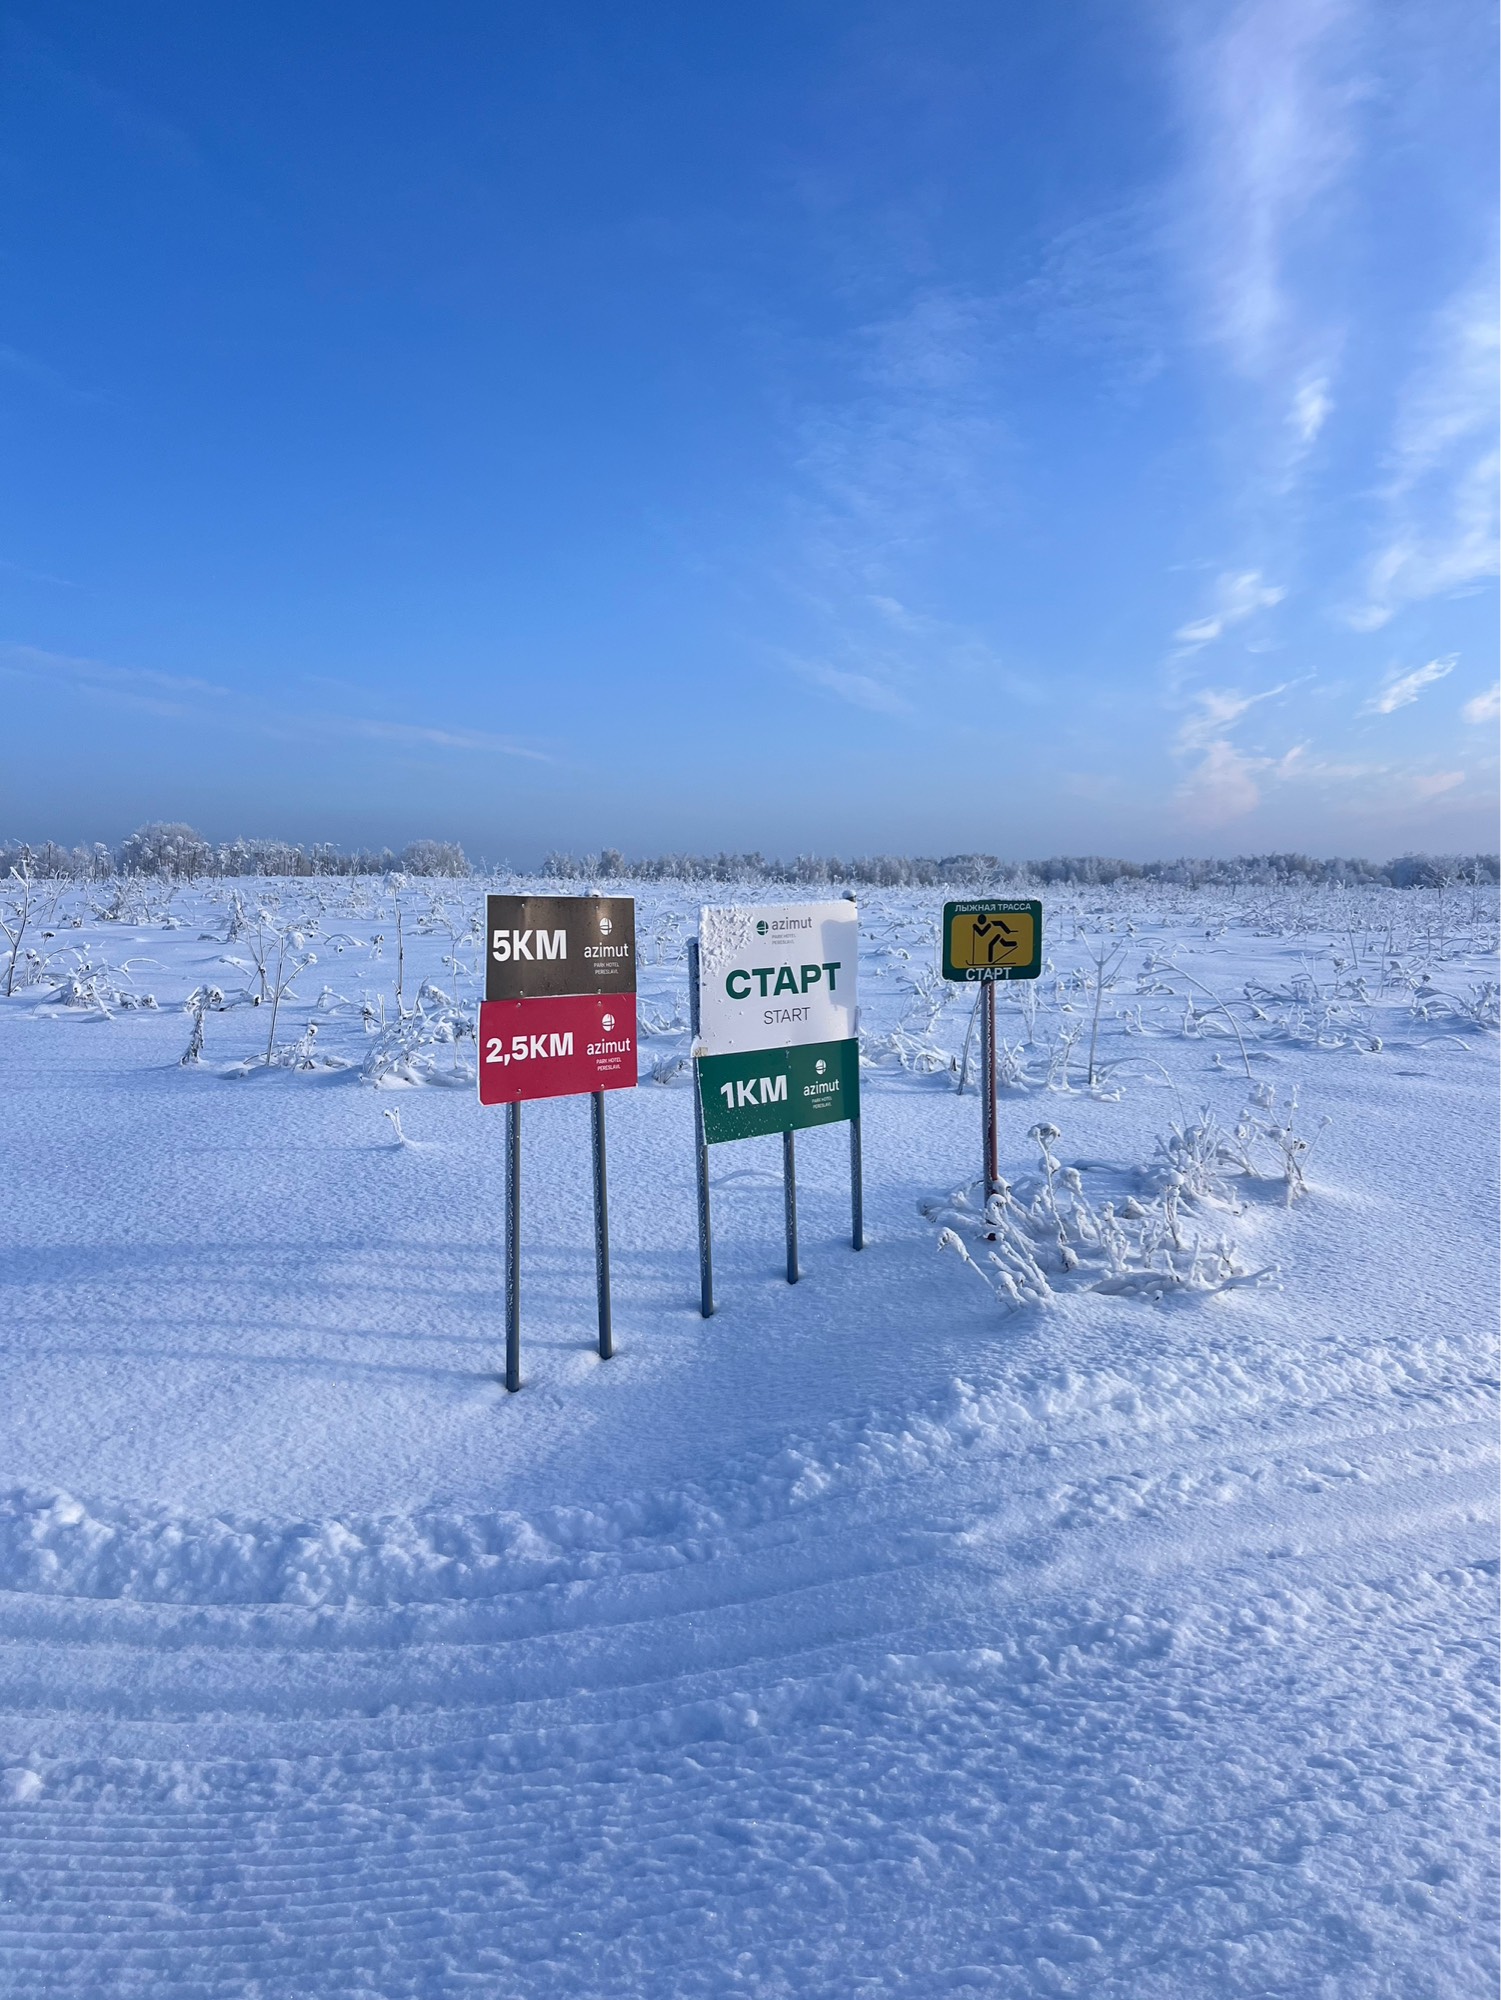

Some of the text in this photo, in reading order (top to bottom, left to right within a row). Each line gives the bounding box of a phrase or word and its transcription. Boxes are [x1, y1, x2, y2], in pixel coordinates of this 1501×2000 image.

[954, 903, 1032, 912] ЛЫЖНАЯ ТРАССА
[771, 916, 813, 931] azimut
[583, 942, 629, 958] azimut
[725, 961, 842, 1000] СТАРТ
[965, 967, 1012, 980] СТАРТ
[763, 1006, 811, 1025] START
[586, 1037, 631, 1055] azimut
[803, 1078, 840, 1097] azimut
